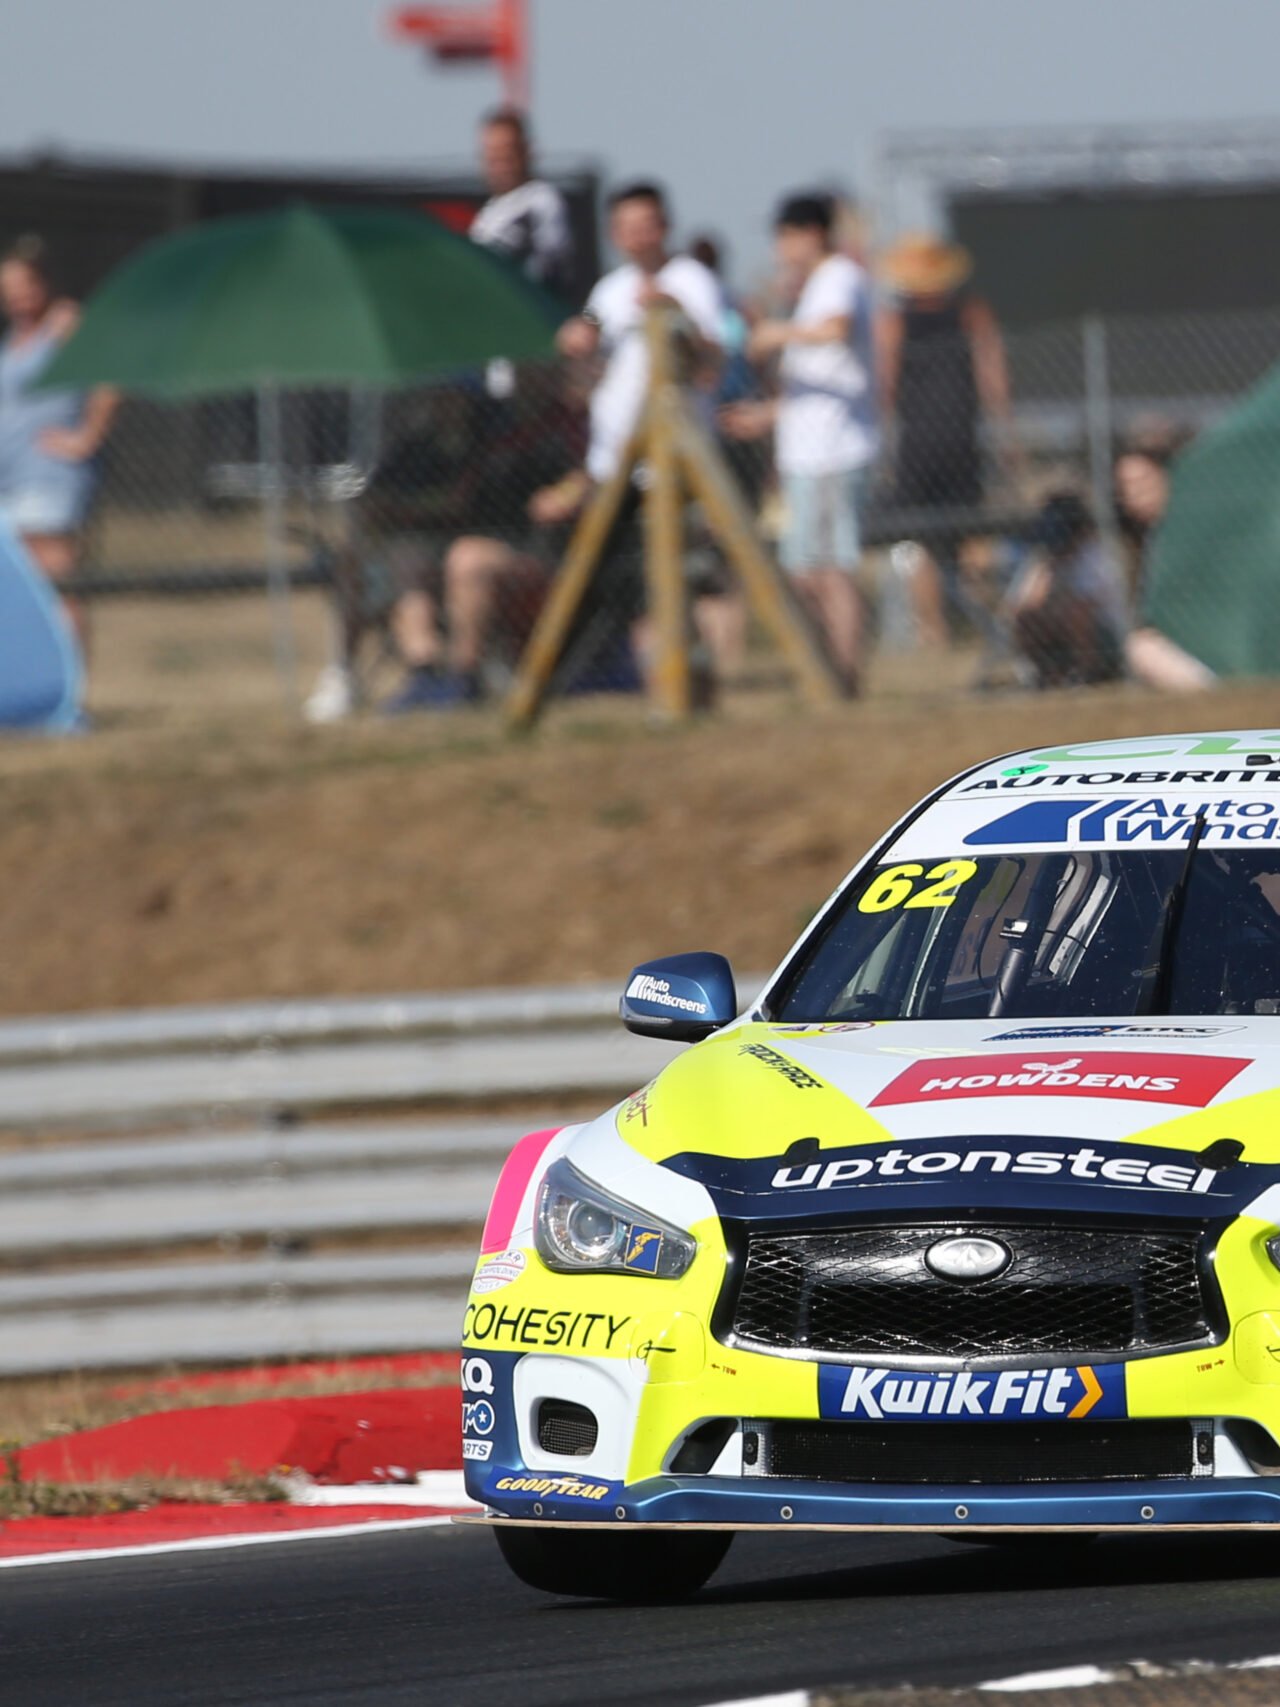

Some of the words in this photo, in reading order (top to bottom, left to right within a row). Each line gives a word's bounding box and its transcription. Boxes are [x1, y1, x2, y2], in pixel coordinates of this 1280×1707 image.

[1120, 799, 1275, 818] Auto
[857, 859, 978, 914] 62
[646, 976, 670, 992] Auto
[642, 987, 707, 1014] Windscreens
[920, 1071, 1181, 1093] HOWDENS
[771, 1148, 1217, 1193] uptonsteel
[495, 1477, 609, 1501] GOODYEAR
